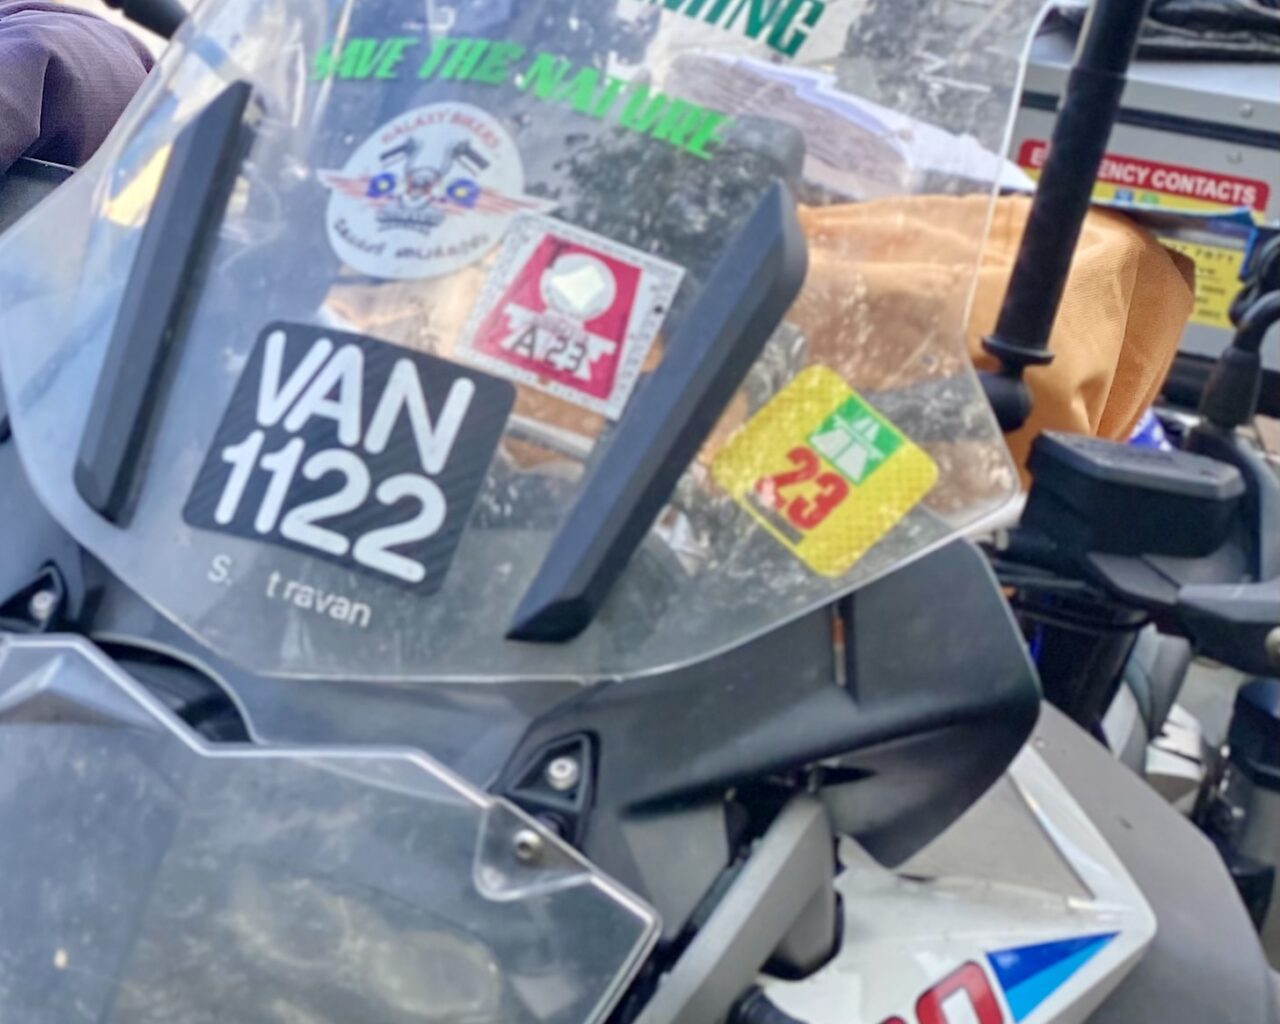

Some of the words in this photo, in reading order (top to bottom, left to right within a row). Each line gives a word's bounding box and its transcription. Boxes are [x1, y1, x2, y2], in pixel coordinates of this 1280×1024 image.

[417, 36, 526, 86] THE
[519, 51, 738, 161] NATURE
[1150, 169, 1258, 206] CONTACTS
[255, 329, 476, 476] VAN
[214, 428, 447, 584] 1122
[753, 445, 851, 532] 23
